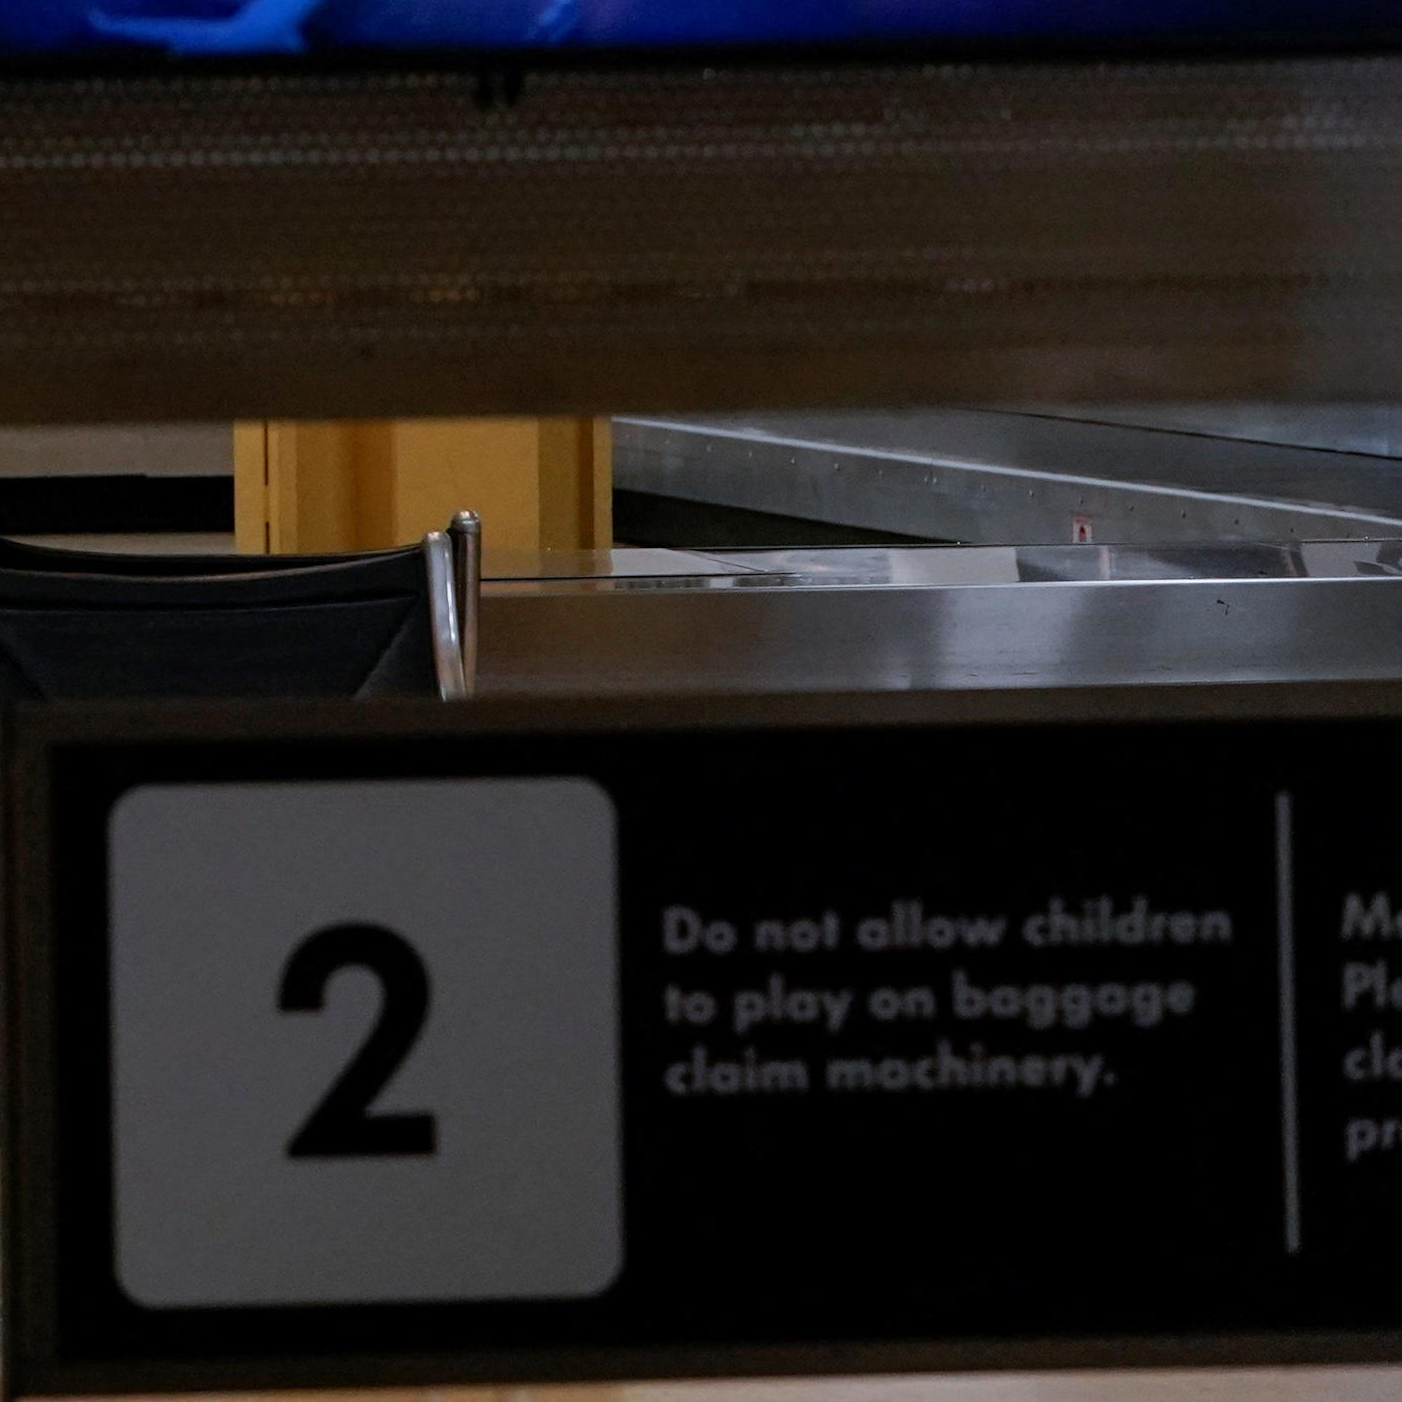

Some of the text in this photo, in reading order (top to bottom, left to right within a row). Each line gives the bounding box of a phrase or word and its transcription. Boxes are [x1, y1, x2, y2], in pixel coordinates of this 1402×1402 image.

[664, 896, 1232, 954] Do not allow children
[665, 971, 1194, 1033] to play on baggage
[276, 920, 438, 1160] 2
[666, 1041, 1118, 1096] claim machinery.
